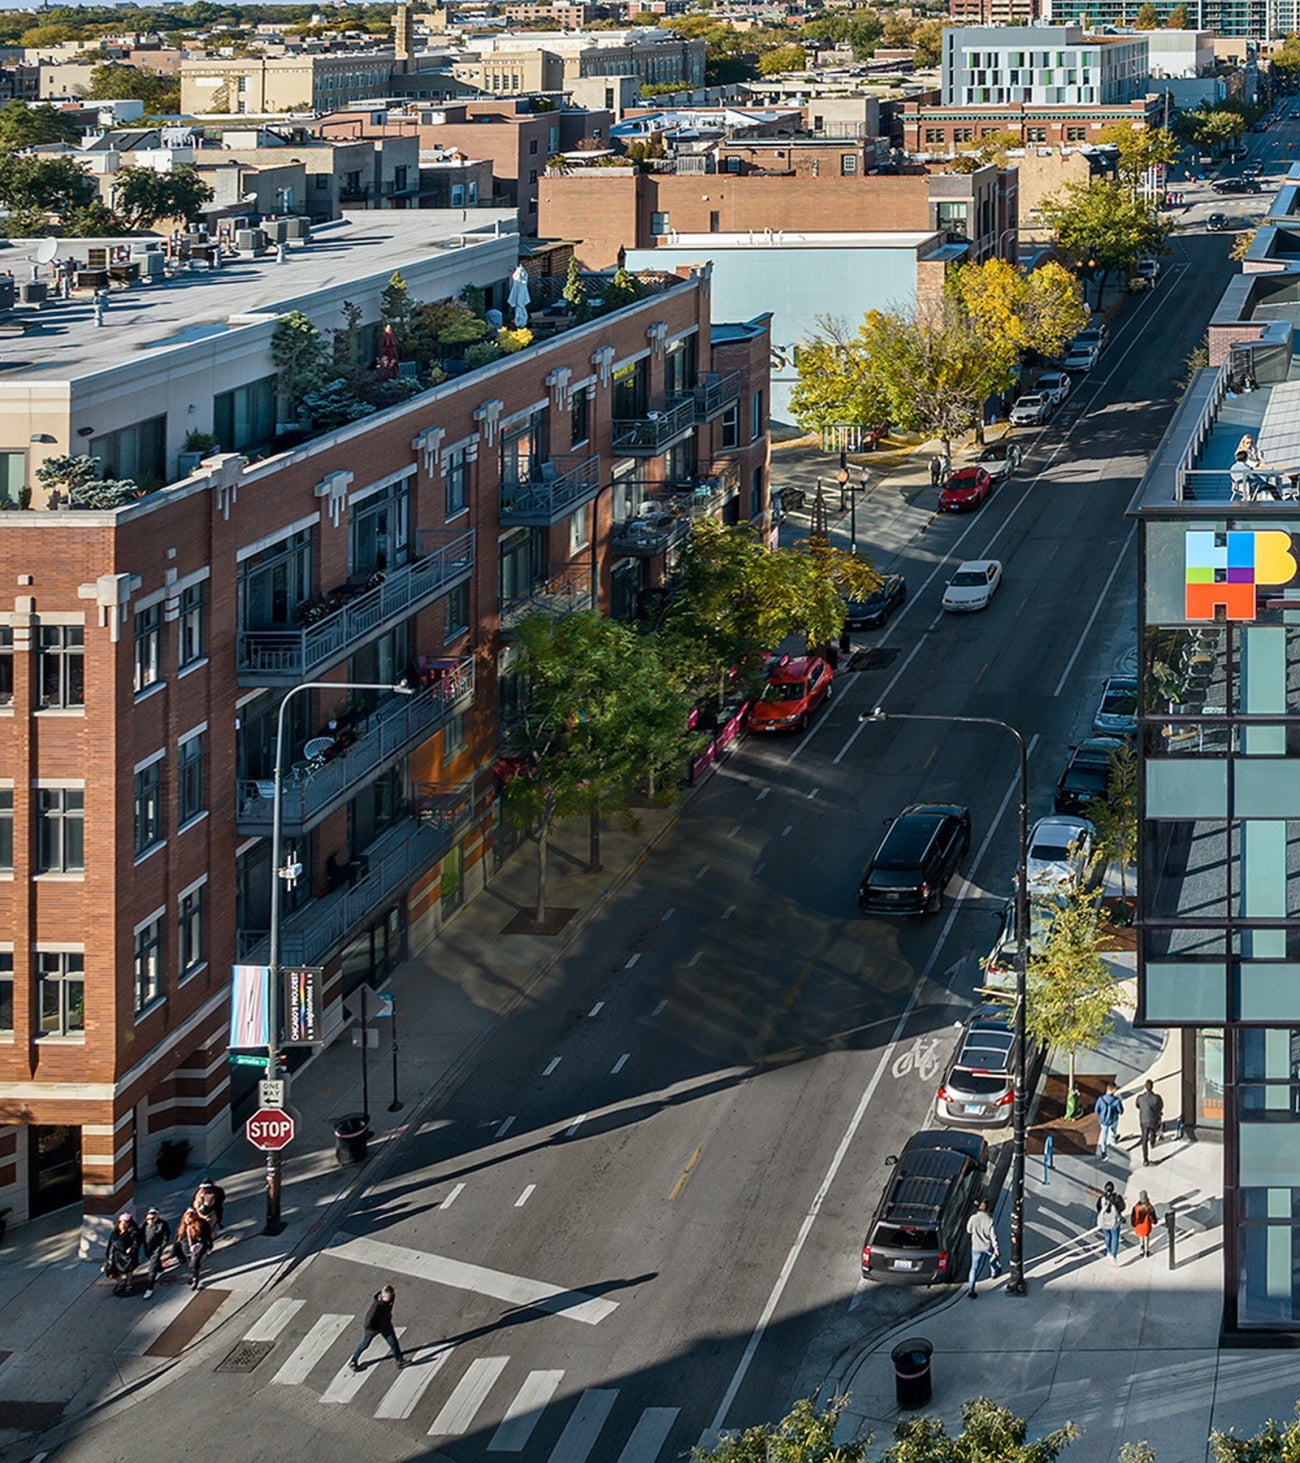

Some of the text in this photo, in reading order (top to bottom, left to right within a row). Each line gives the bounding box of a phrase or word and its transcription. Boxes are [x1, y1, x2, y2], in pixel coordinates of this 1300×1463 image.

[291, 972, 299, 1041] CHICAGO'S PROUDEST
[306, 985, 315, 1027] neighborhood
[250, 1121, 291, 1138] STOP
